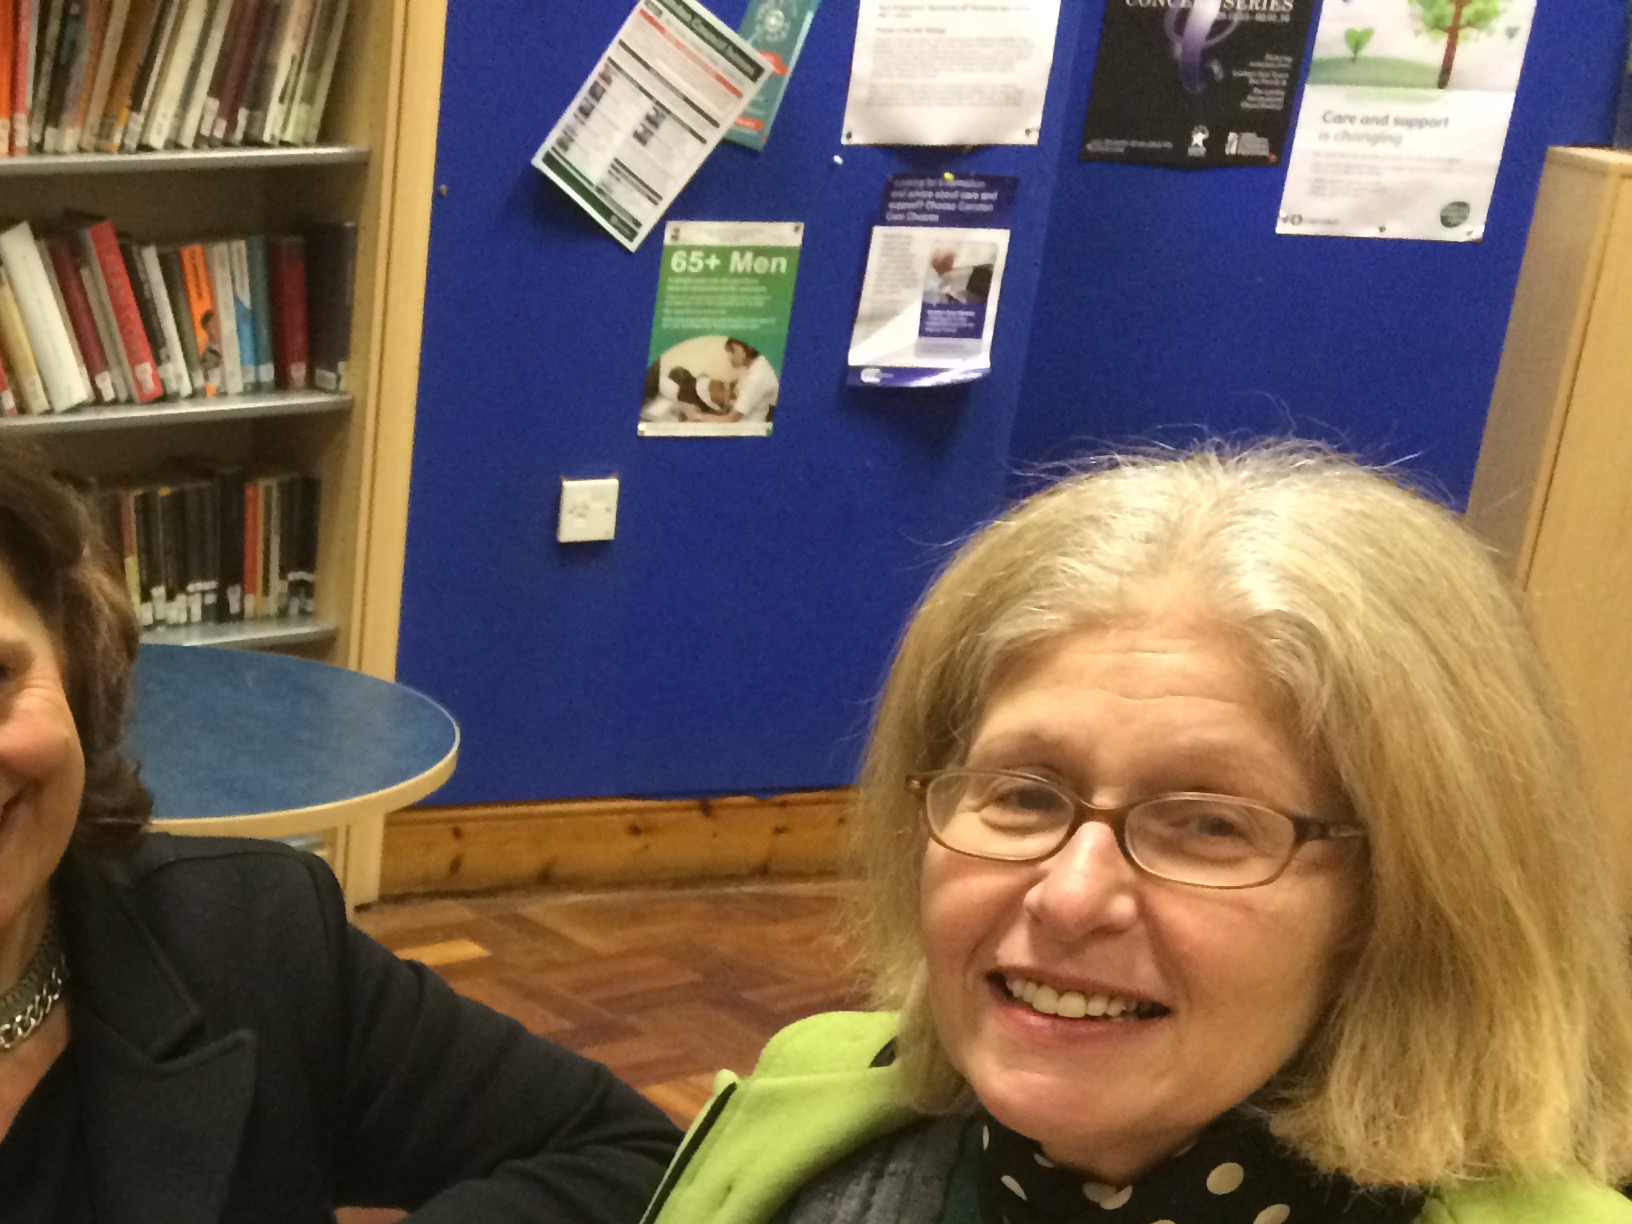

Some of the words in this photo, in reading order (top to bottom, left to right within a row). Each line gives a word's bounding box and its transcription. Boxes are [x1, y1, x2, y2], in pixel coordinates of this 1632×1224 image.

[1322, 110, 1358, 124] Care
[1360, 113, 1389, 126] and
[1393, 115, 1449, 130] support
[670, 249, 721, 273] 65+
[729, 250, 787, 274] Men
